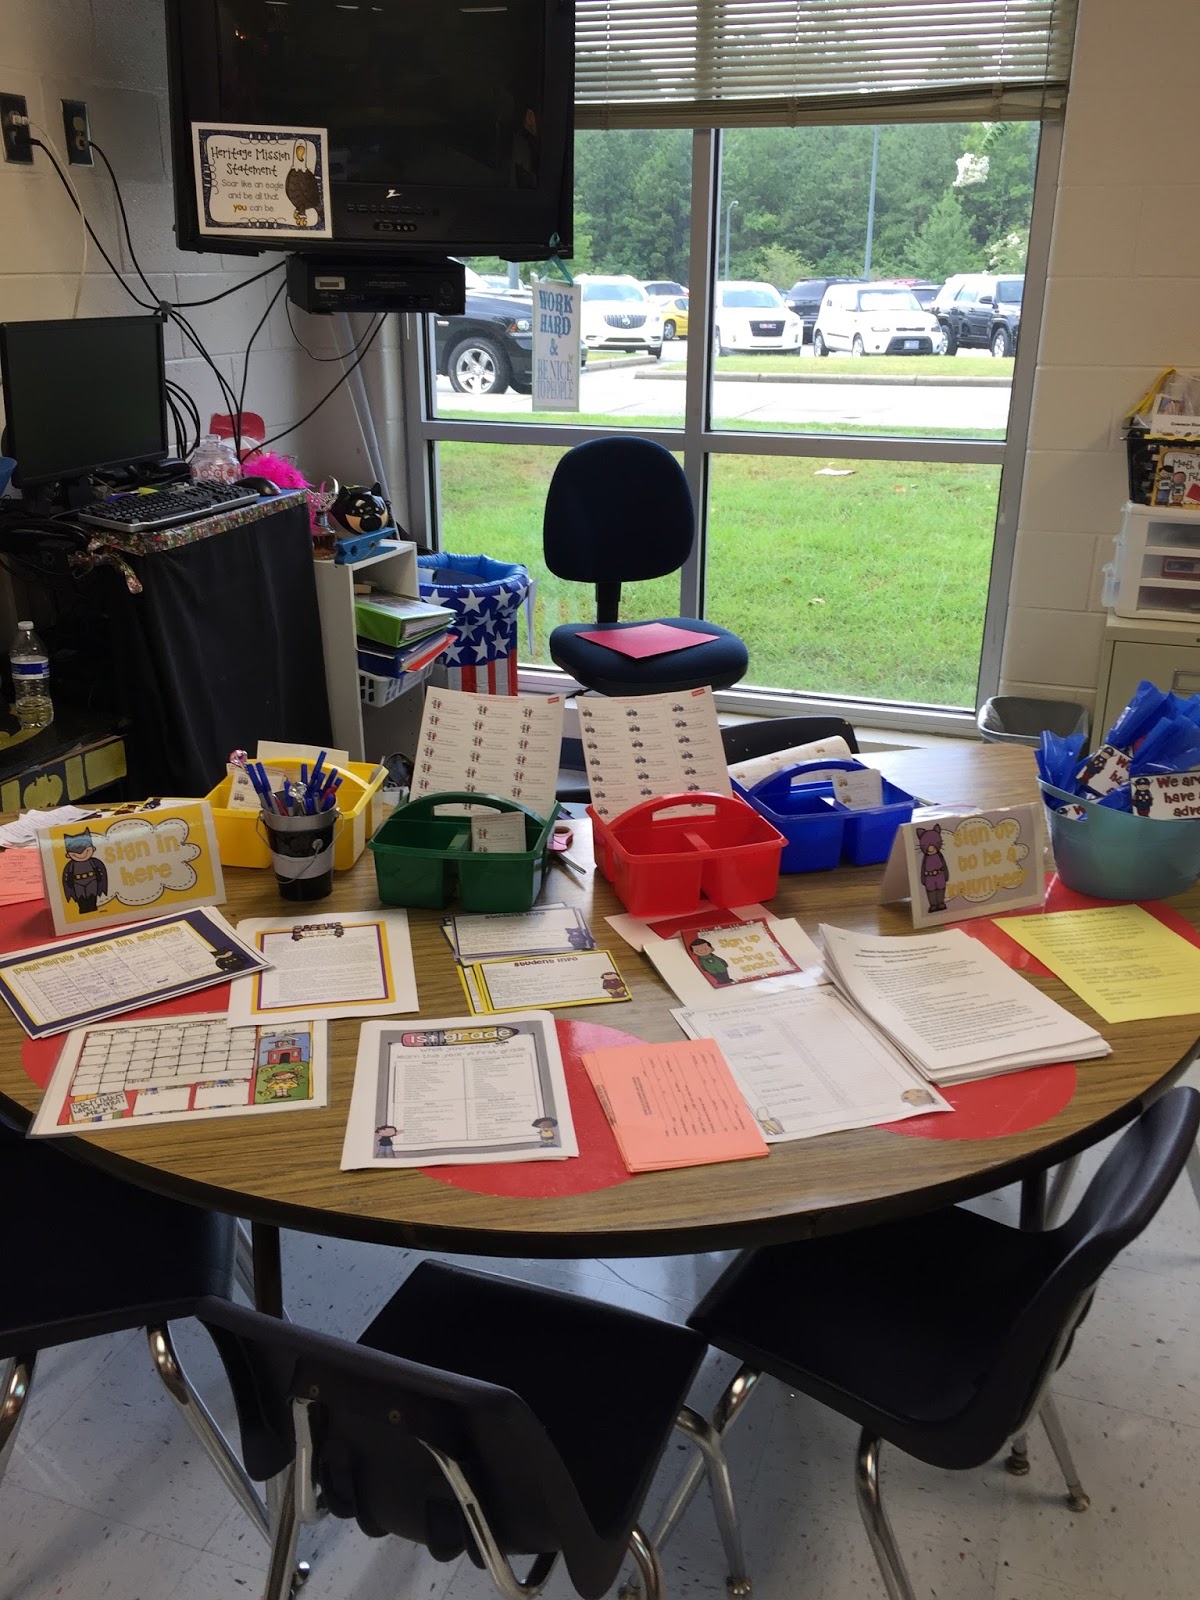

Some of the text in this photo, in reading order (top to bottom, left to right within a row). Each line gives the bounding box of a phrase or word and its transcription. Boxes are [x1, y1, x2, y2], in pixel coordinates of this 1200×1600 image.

[211, 147, 290, 161] Heritage Mission
[226, 163, 277, 177] Statement
[222, 179, 239, 187] Soar
[241, 180, 252, 188] like
[266, 181, 284, 190] eagle
[264, 192, 279, 200] that
[233, 204, 247, 213] you
[265, 204, 274, 212] be
[539, 290, 573, 316] WORK
[540, 314, 572, 338] HARD
[549, 338, 558, 356] &
[537, 359, 573, 381] BE NICE
[546, 381, 574, 400] PEOPLE
[1156, 776, 1179, 788] We
[1164, 792, 1195, 804] have
[954, 822, 1015, 848] sign up
[104, 834, 180, 863] sign in
[957, 847, 1017, 872] to be a
[120, 863, 172, 887] here
[78, 944, 113, 958] sign
[114, 938, 134, 947] in
[410, 1028, 510, 1044] 1st grade
